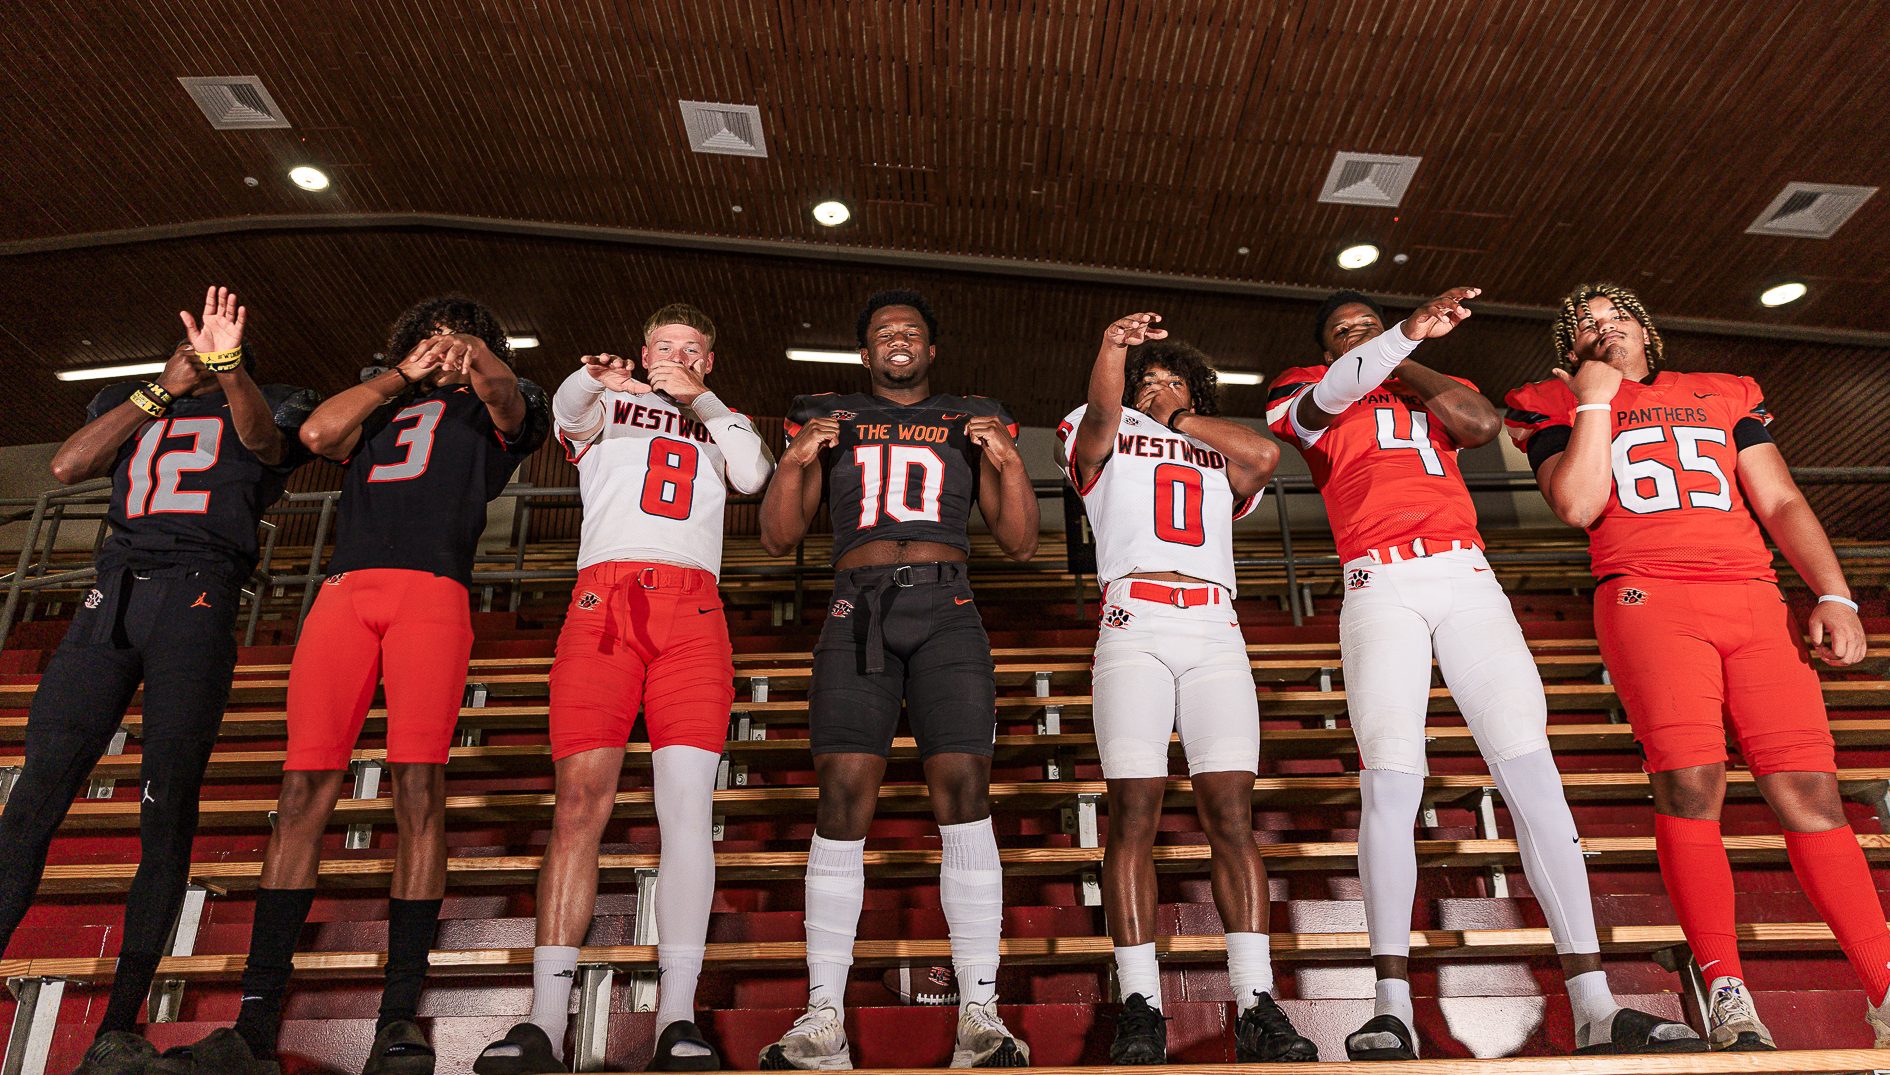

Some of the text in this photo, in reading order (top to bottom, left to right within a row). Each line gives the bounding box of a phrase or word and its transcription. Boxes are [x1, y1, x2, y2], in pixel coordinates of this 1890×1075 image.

[367, 400, 447, 482] 3
[856, 424, 949, 443] THE WOOD
[1357, 393, 1425, 406] PANTHE
[1617, 407, 1707, 427] PANTHERS
[126, 416, 224, 519] 12
[640, 436, 699, 520] 8
[1374, 407, 1446, 477] 4
[1611, 425, 1732, 515] 65
[854, 443, 945, 530] 10
[1154, 463, 1206, 547] 0
